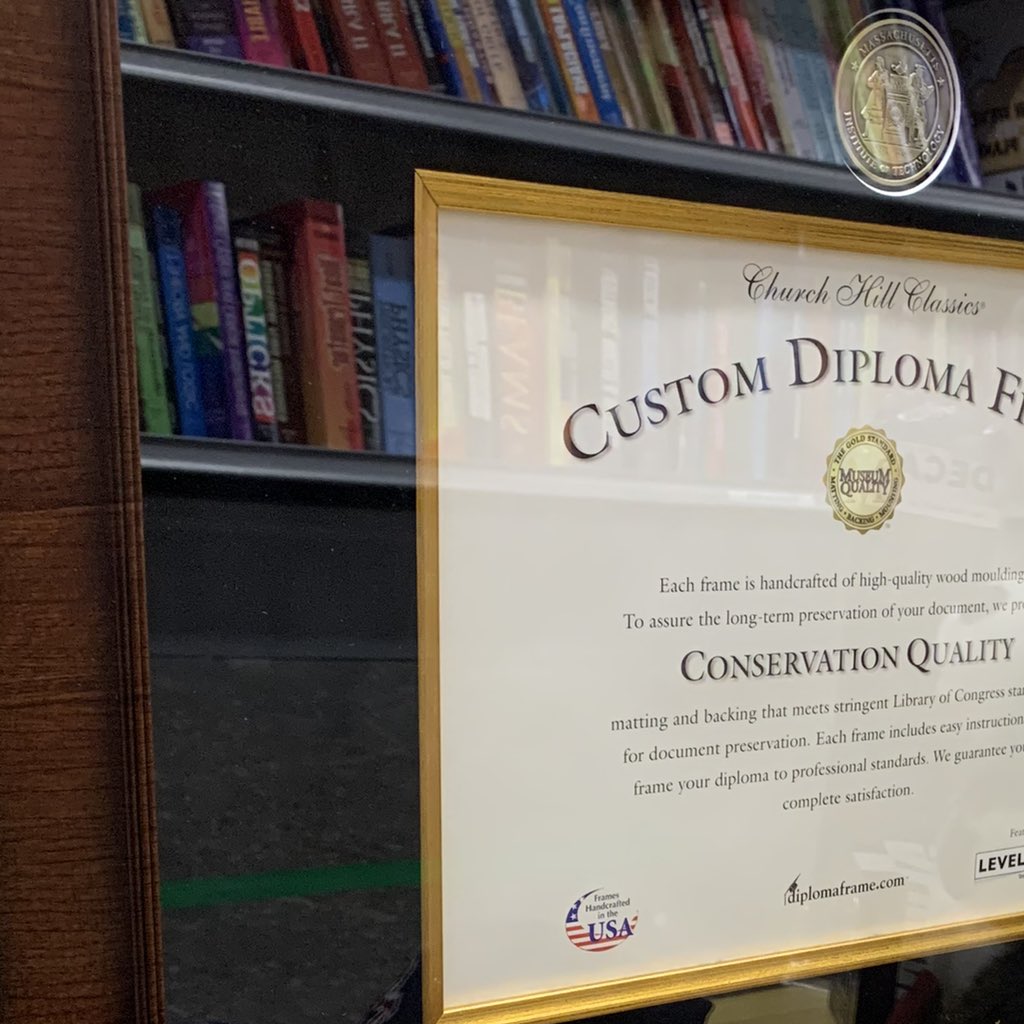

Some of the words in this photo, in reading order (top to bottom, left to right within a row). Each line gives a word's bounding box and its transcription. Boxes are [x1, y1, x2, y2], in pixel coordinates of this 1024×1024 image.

[891, 124, 945, 176] TECHNOLOGY
[743, 263, 829, 305] Church
[836, 273, 900, 309] Hill
[563, 356, 771, 460] CUSTOM
[785, 337, 976, 404] DIPLOMA
[834, 448, 846, 464] THE
[846, 435, 866, 449] GOLD
[867, 435, 896, 466] STANDARD
[839, 468, 892, 482] MUSEUM
[840, 480, 890, 498] QUALITY
[659, 577, 695, 594] Each
[699, 576, 740, 593] frame
[745, 575, 756, 591] is
[760, 573, 838, 591] handcrafted
[842, 572, 858, 588] of
[859, 570, 932, 591] high-quality
[936, 569, 968, 584] wood
[623, 613, 645, 629] To
[649, 615, 693, 629] assure
[699, 611, 721, 626] the
[726, 610, 795, 629] long-term
[799, 605, 877, 627] preservation
[881, 603, 897, 619] of
[897, 606, 925, 622] your
[928, 601, 990, 617] document,
[993, 600, 1009, 612] we
[680, 644, 900, 682] CONSERVATION
[907, 637, 1016, 673] QUALITY
[611, 714, 668, 731] matting
[673, 709, 699, 726] and
[704, 706, 757, 724] backing
[762, 704, 788, 719] that
[792, 703, 830, 717] meets
[834, 698, 888, 715] stringent
[893, 693, 936, 710] Library
[939, 689, 954, 704] of
[954, 688, 1005, 704] Congress
[623, 748, 644, 764] for
[649, 744, 720, 761] document
[725, 734, 811, 758] preservation.
[816, 730, 847, 746] Each
[851, 727, 885, 743] frame
[889, 721, 937, 739] includes
[940, 721, 963, 736] easy
[633, 780, 674, 796] frame
[678, 776, 711, 795] your
[714, 770, 769, 790] diploma
[774, 769, 788, 781] to
[791, 758, 867, 783] professional
[870, 752, 930, 772] standards.
[933, 749, 951, 763] We
[954, 745, 1007, 765] guarantee
[782, 791, 841, 812] complete
[845, 784, 915, 803] satisfaction.
[585, 898, 630, 912] Handcrafted
[594, 893, 619, 902] Frames
[787, 876, 905, 905] diplomaframe.com
[598, 911, 605, 920] in
[607, 910, 618, 918] the
[588, 917, 634, 943] USA
